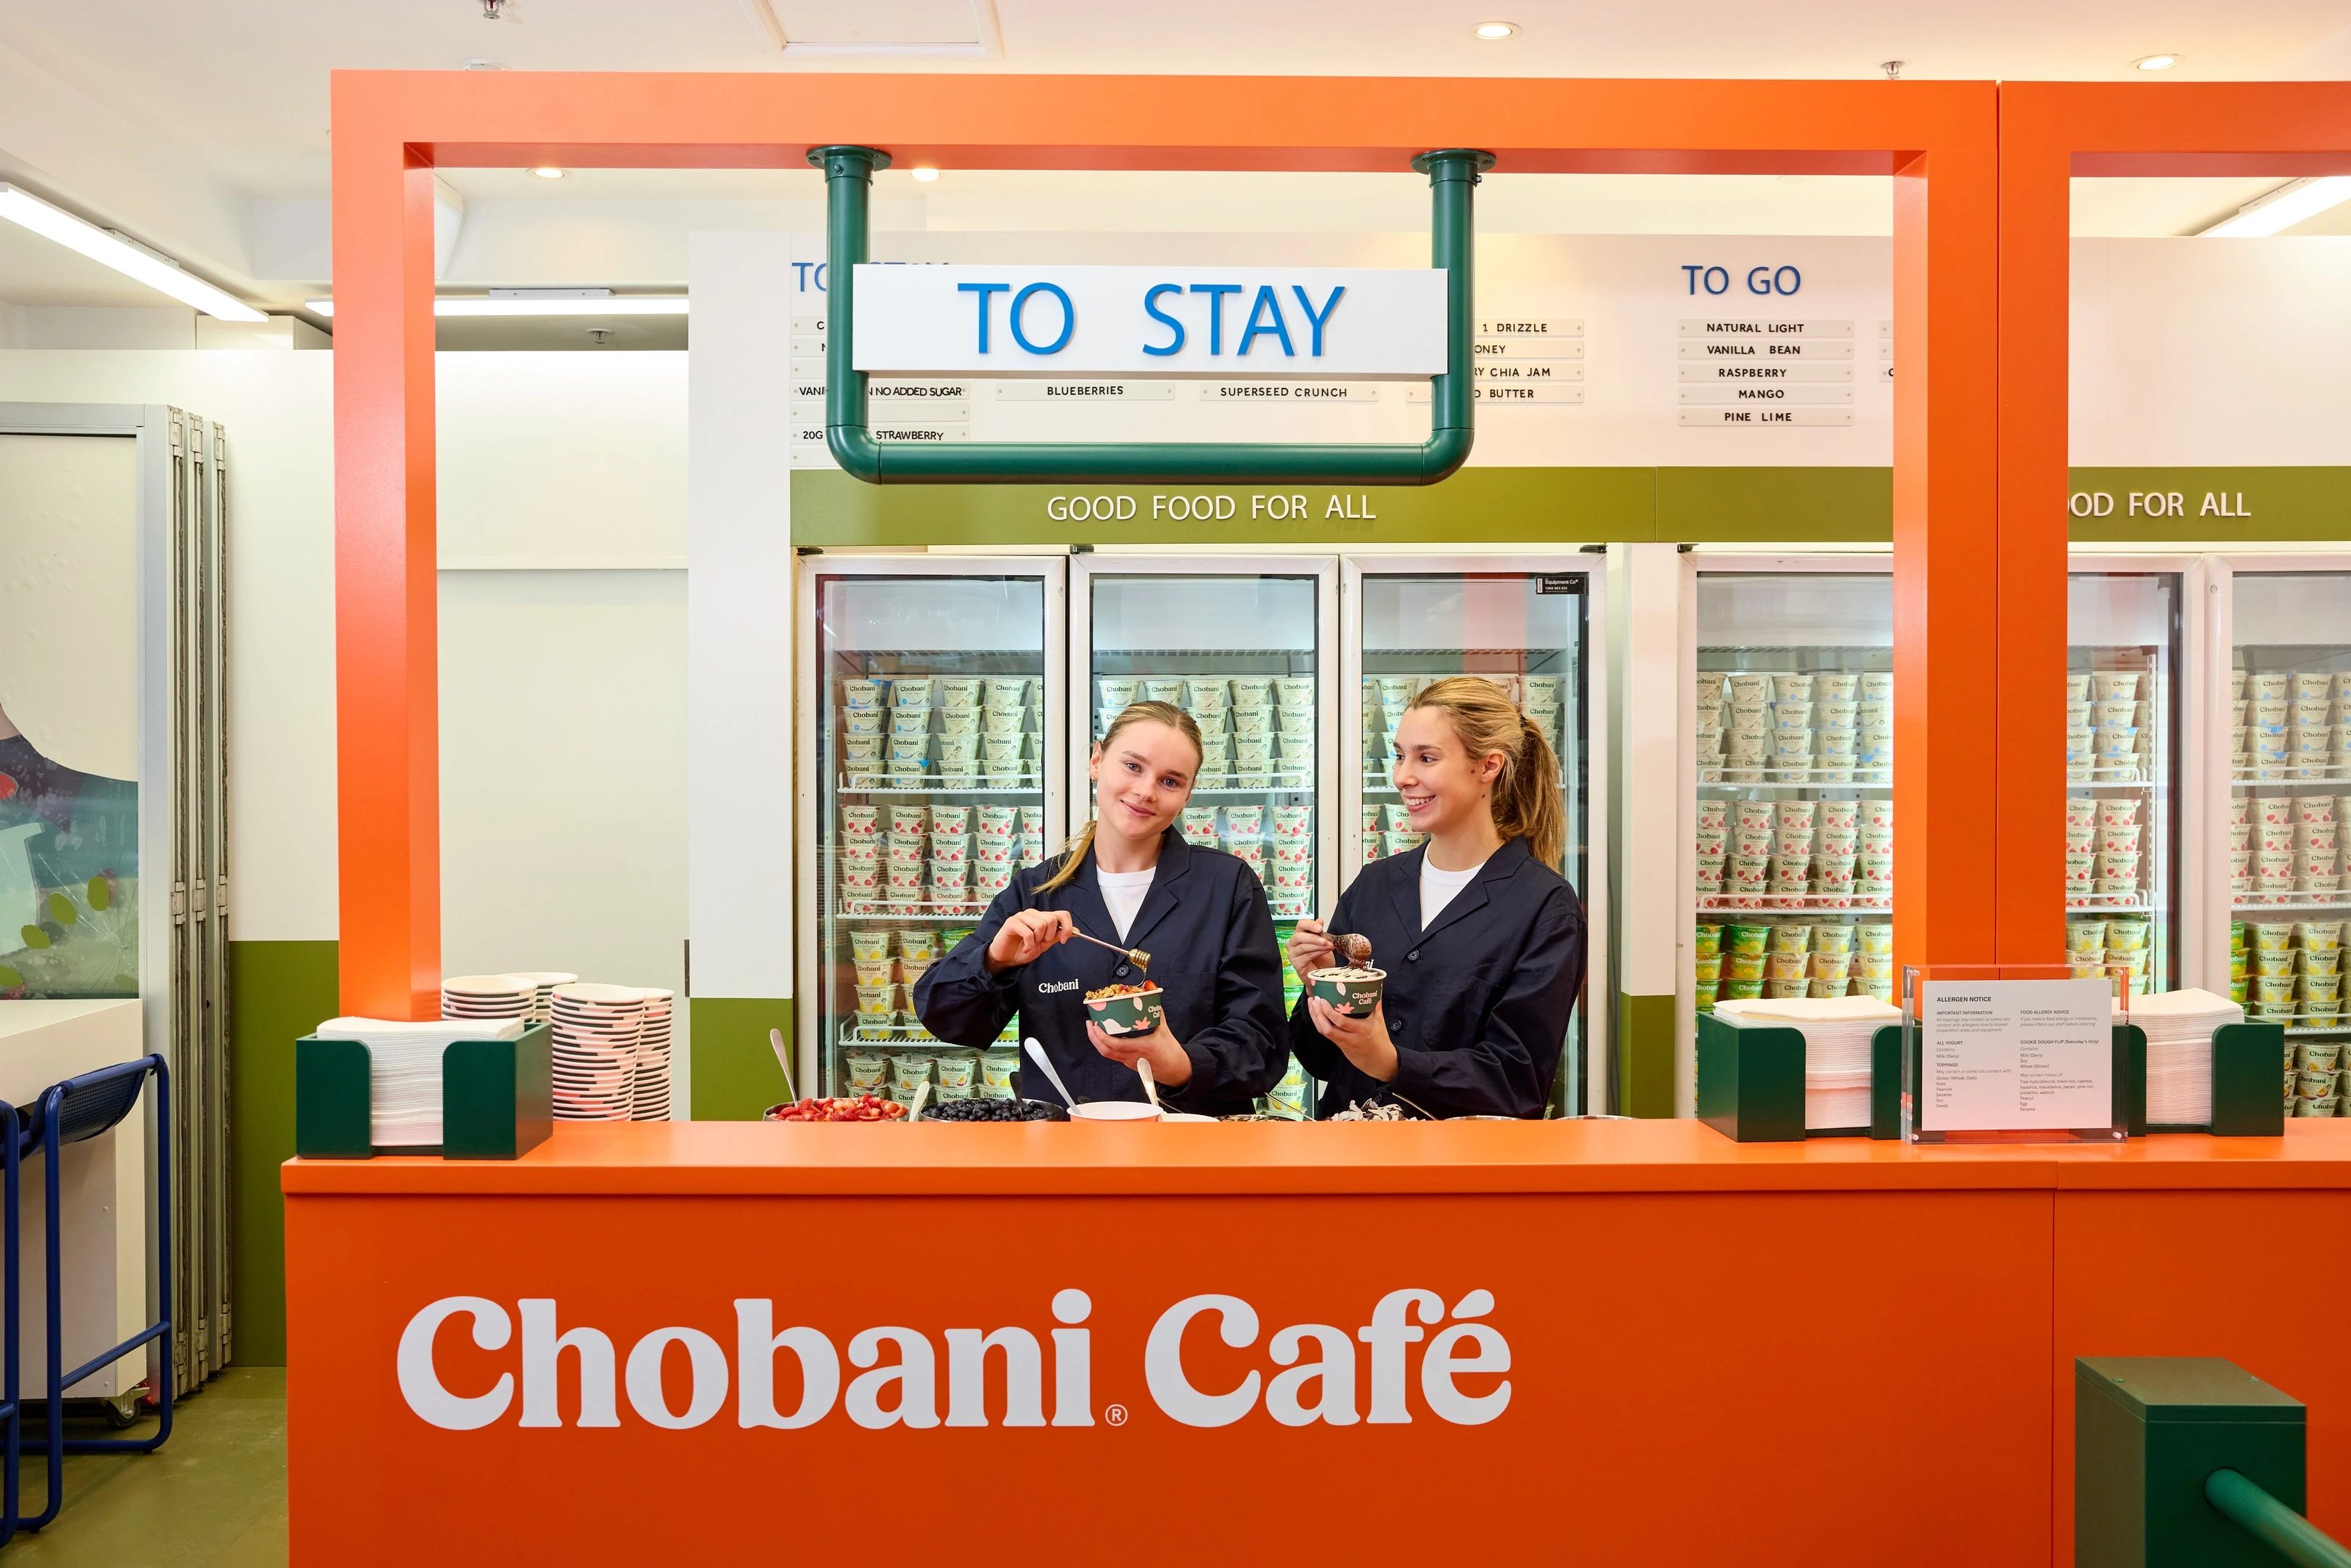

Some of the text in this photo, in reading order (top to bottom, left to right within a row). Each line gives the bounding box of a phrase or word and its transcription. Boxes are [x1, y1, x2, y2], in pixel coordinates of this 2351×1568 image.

[1681, 265, 1801, 295] TO GO
[957, 282, 1345, 357] TO STAY
[1483, 323, 1547, 332] 1 DRIZZLE
[1706, 323, 1804, 333] NATURAL LIGHT
[1475, 345, 1506, 354] ONEY
[1707, 346, 1801, 355] VANILLA BEAN
[1490, 368, 1520, 377] CHIA
[1527, 367, 1550, 377] JAM
[1719, 368, 1787, 377] RASPBERRY
[799, 386, 826, 396] VANI
[876, 387, 891, 396] NO
[892, 387, 927, 396] ADDED
[929, 387, 962, 396] SUGAR
[1047, 385, 1124, 396] BLUEBERRIES
[1221, 387, 1348, 397] SUPERSEED CRUNCH
[1490, 389, 1534, 399] BUTTER
[1738, 389, 1785, 399] MANGO
[1724, 412, 1792, 422] PINE LIME
[802, 430, 944, 441] 20G STRAWBERRY
[1047, 494, 1377, 521] GOOD FOOD FOR ALL
[2068, 492, 2252, 517] OD FOR ALL
[1038, 978, 1080, 994] Chobani
[1352, 990, 1378, 1000] Chobani
[1152, 1010, 1161, 1018] Caf
[1144, 1288, 1512, 1426] Café
